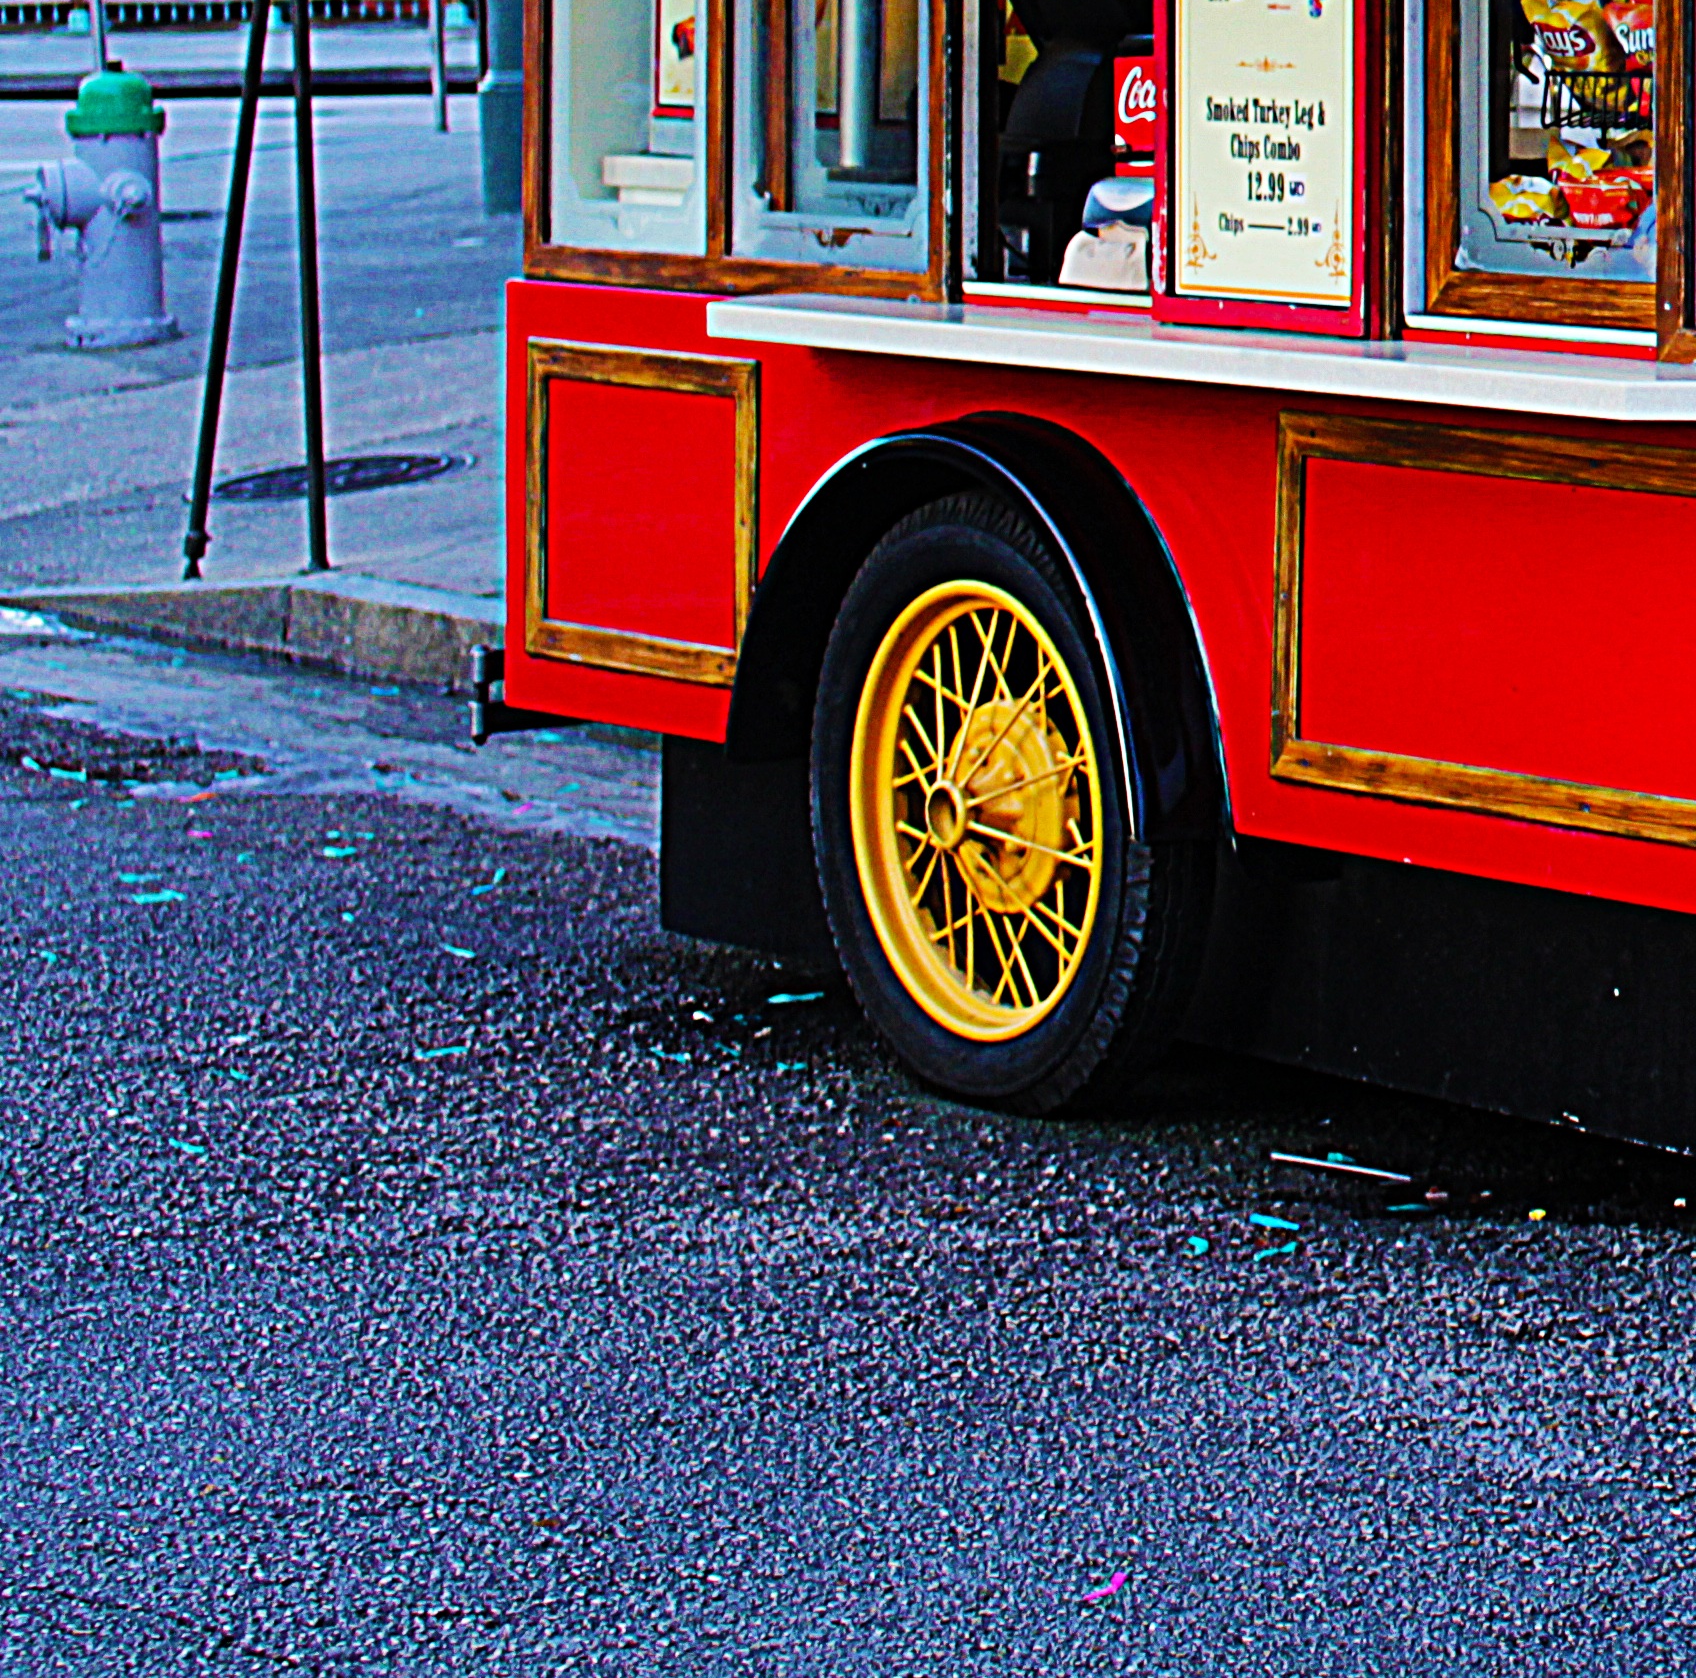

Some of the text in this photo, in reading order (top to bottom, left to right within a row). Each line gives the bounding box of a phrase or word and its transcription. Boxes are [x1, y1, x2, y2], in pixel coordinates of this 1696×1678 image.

[1206, 95, 1249, 123] Smoked
[1252, 97, 1291, 129] Turkey
[1294, 99, 1314, 131] Leg
[1230, 133, 1301, 163] Chips Combo
[1247, 171, 1285, 203] 12.99
[1219, 212, 1244, 237] Chips
